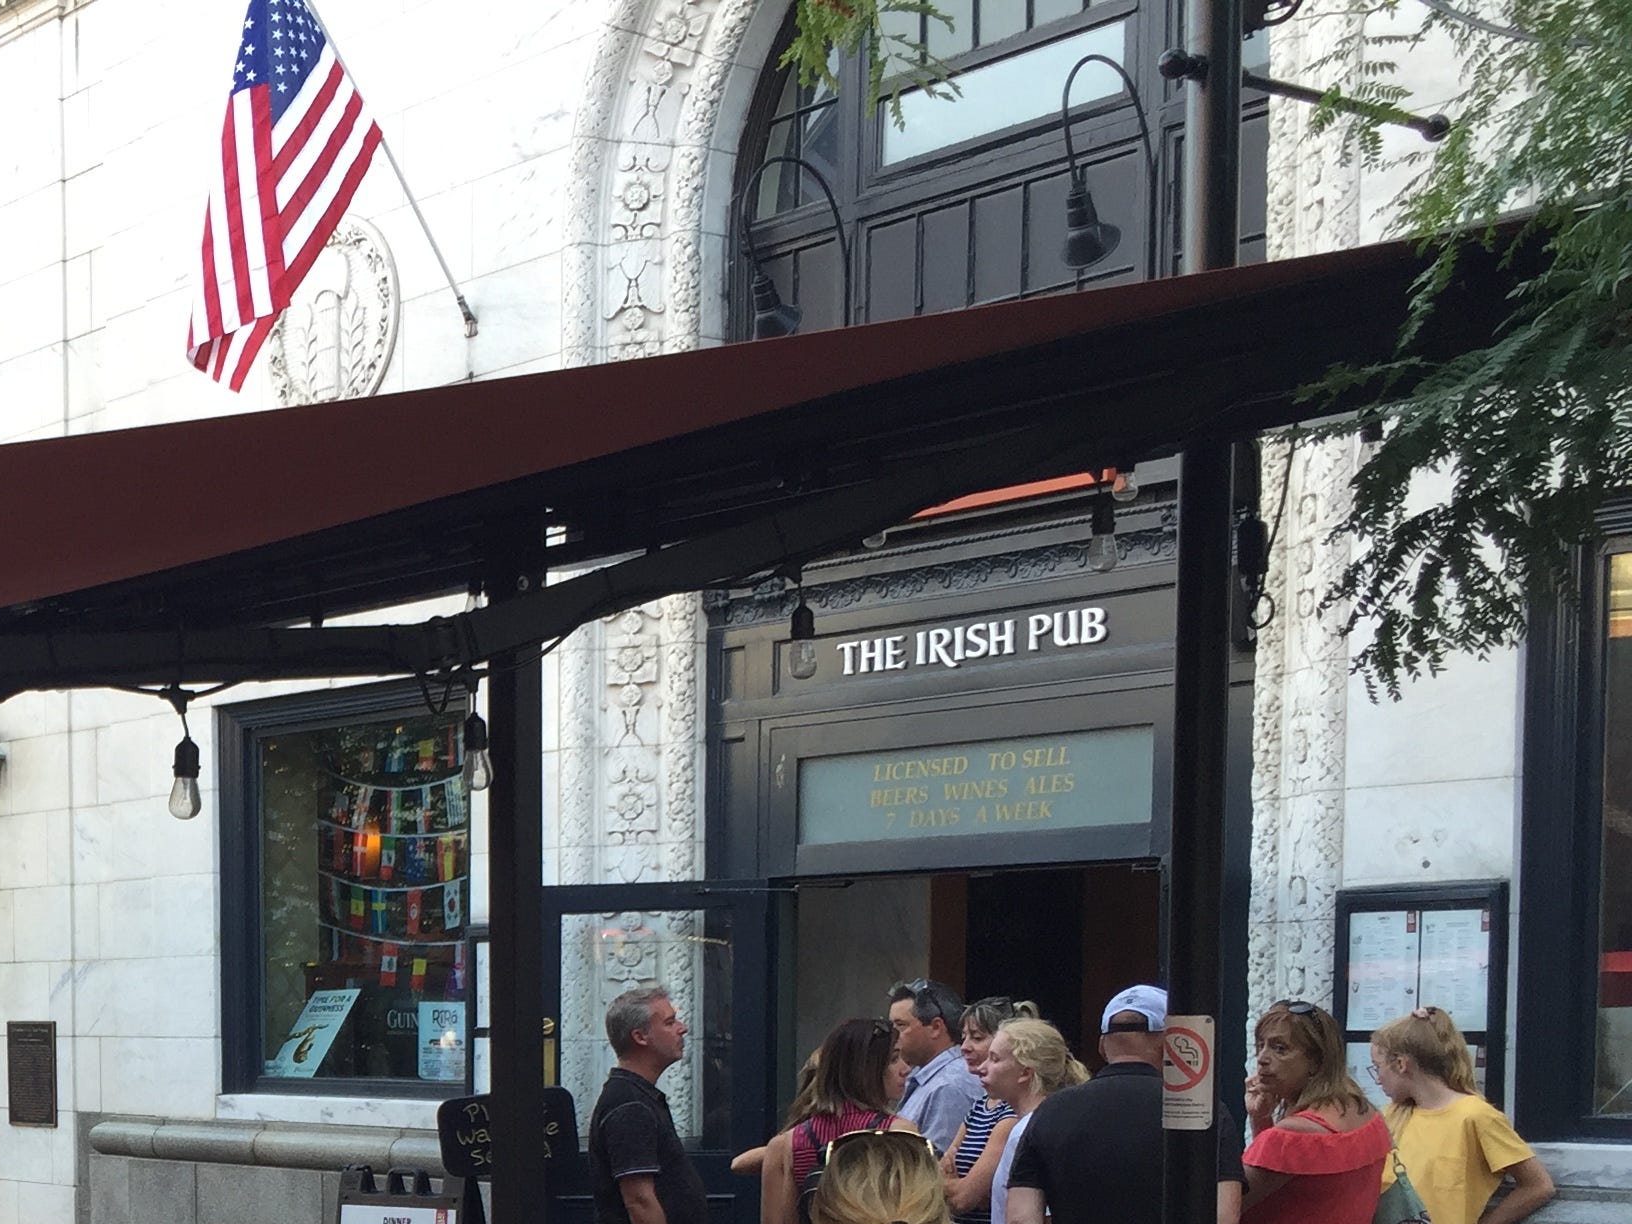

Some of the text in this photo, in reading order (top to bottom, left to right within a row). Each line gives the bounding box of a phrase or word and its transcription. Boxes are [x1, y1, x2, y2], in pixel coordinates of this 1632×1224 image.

[836, 607, 1108, 676] THE IRISH PUB
[872, 746, 1072, 783] LICENSED TO SELL
[869, 773, 1076, 809] BEERS WINES ALES
[908, 807, 961, 830] DAYS
[993, 800, 1054, 822] WEEK
[387, 1009, 419, 1029] GUIN
